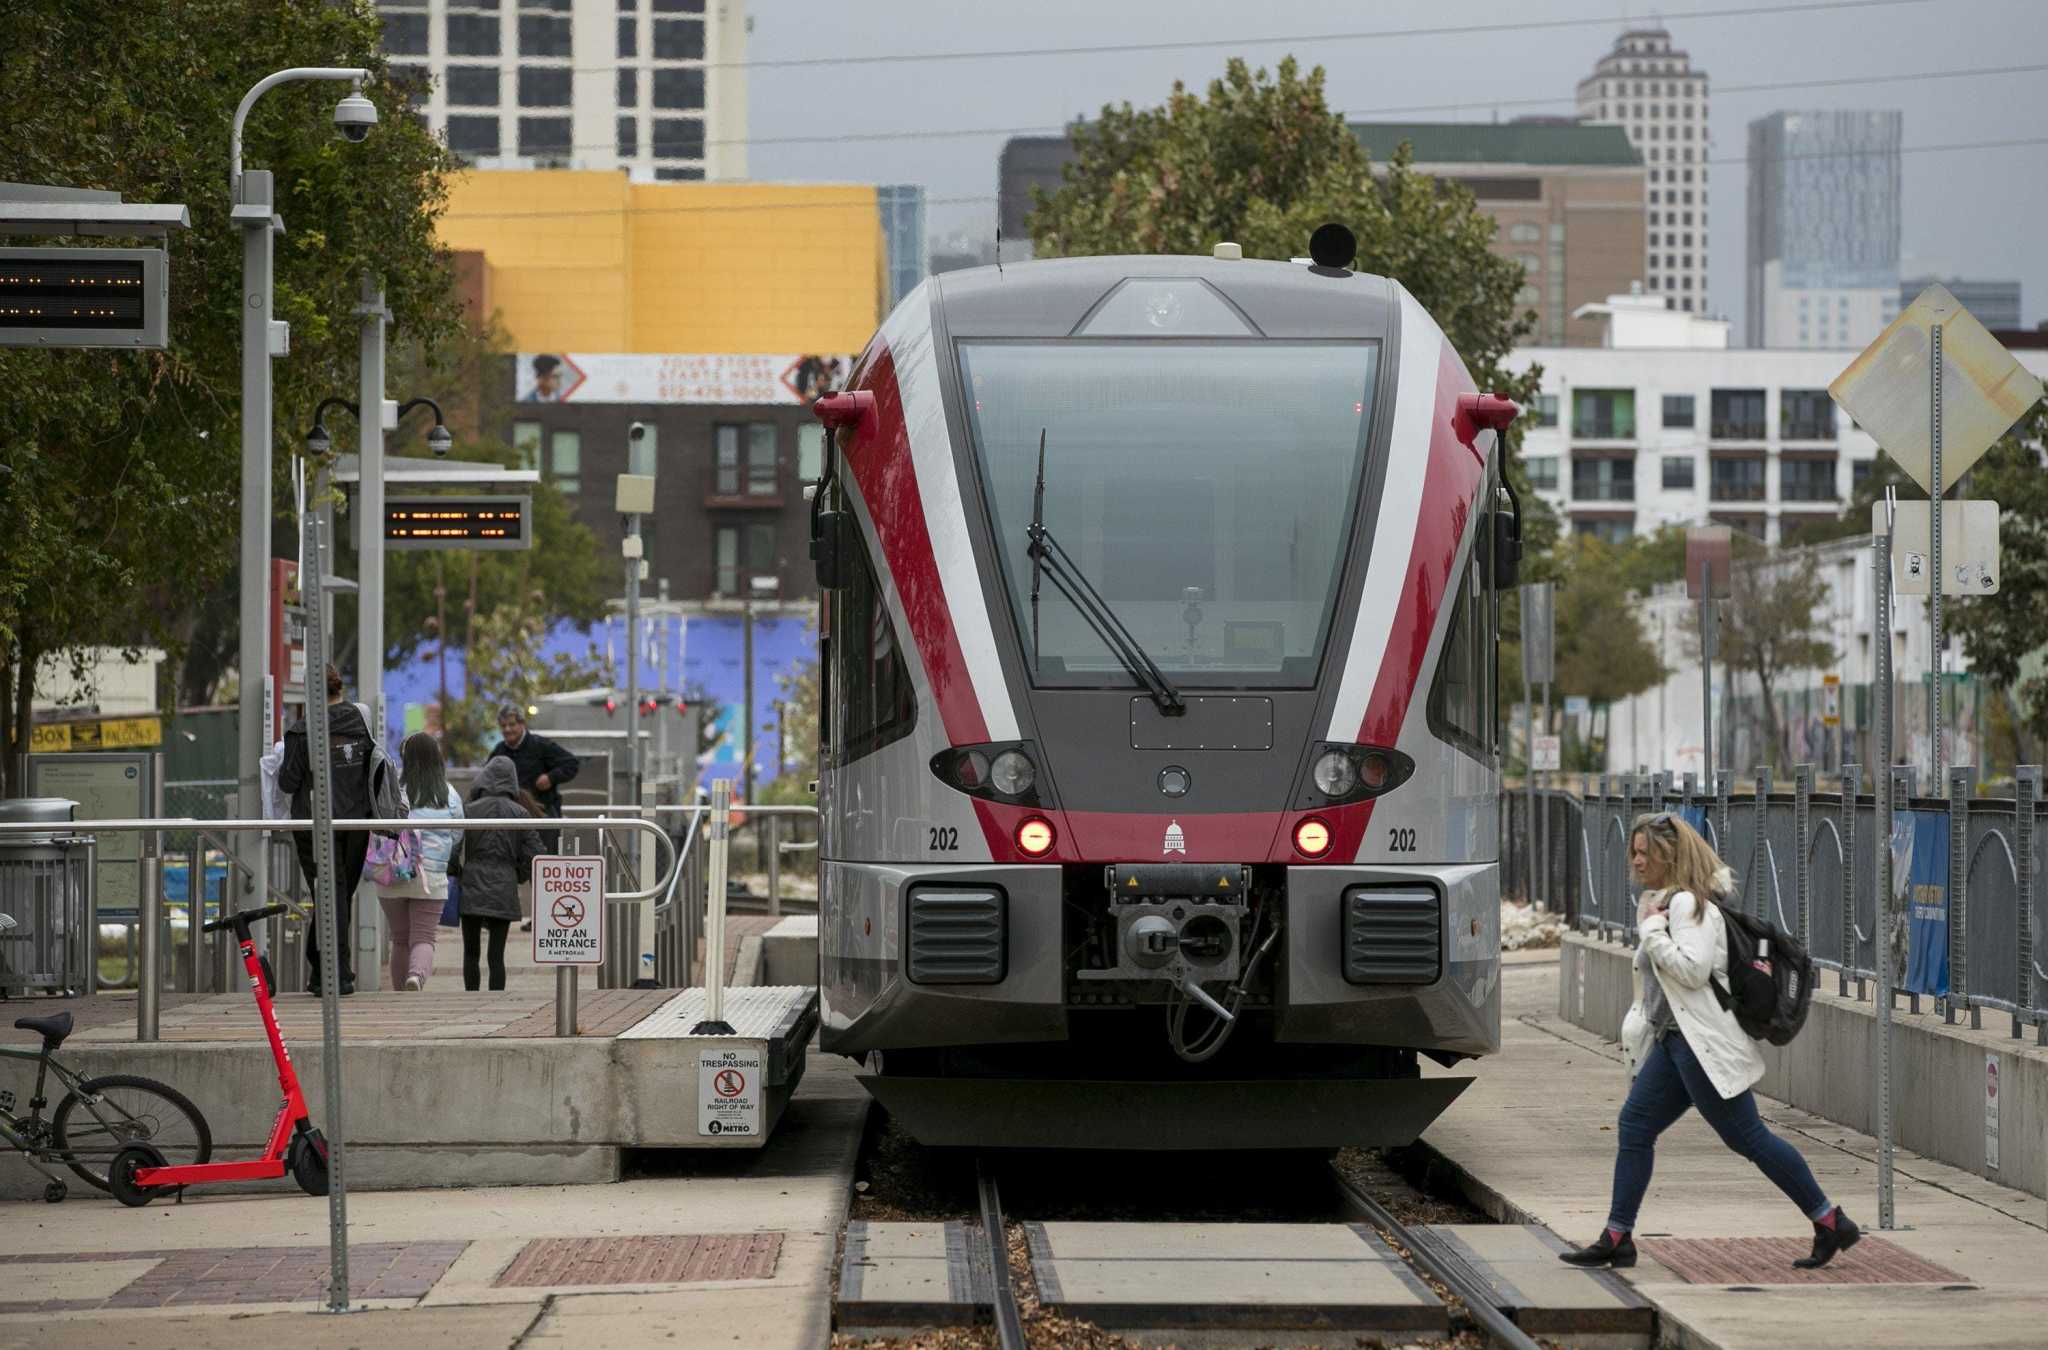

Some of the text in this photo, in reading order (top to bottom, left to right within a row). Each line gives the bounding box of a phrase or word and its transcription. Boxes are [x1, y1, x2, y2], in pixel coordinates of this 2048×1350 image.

[929, 827, 958, 850] 202
[1389, 828, 1416, 851] 202
[543, 867, 594, 879] DO NOT
[544, 881, 591, 892] CROSS
[547, 928, 587, 938] NOT AN
[539, 938, 597, 948] ENTRANCE
[702, 1060, 759, 1068] TRESPASSING
